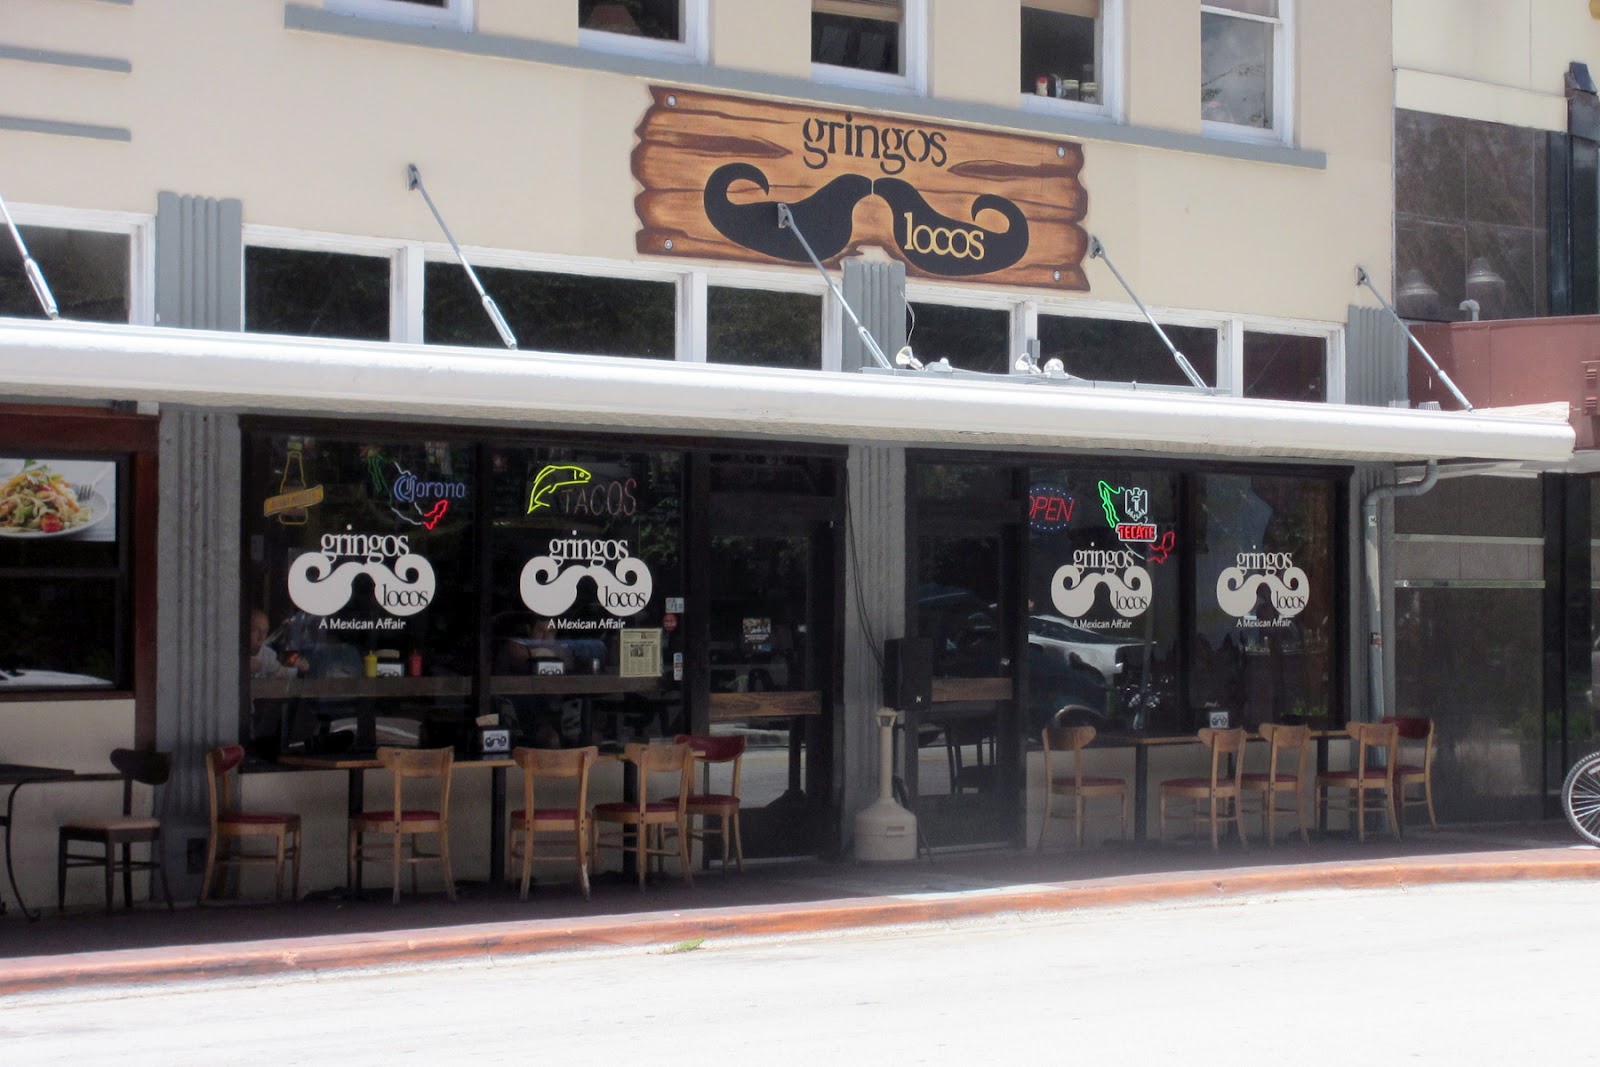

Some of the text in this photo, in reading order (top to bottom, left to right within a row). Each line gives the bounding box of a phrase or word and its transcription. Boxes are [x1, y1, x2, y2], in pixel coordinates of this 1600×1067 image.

[803, 114, 948, 175] gringos
[903, 211, 985, 260] locos
[394, 475, 465, 503] Corona
[562, 478, 637, 516] TACOS
[321, 524, 410, 564] gringos
[1118, 525, 1155, 540] TECATE
[549, 529, 629, 569] gringos
[1073, 541, 1135, 576] gringos
[1236, 545, 1293, 577] gringos
[382, 584, 429, 607] locos
[604, 586, 647, 608] locos
[1115, 591, 1148, 610] locos
[1276, 591, 1306, 609] locos
[318, 618, 407, 630] A Mexican Affair
[547, 618, 626, 629] A Mexican Affair
[1072, 619, 1132, 629] A Mexican Affair
[1236, 618, 1291, 628] A Mexican Affair
